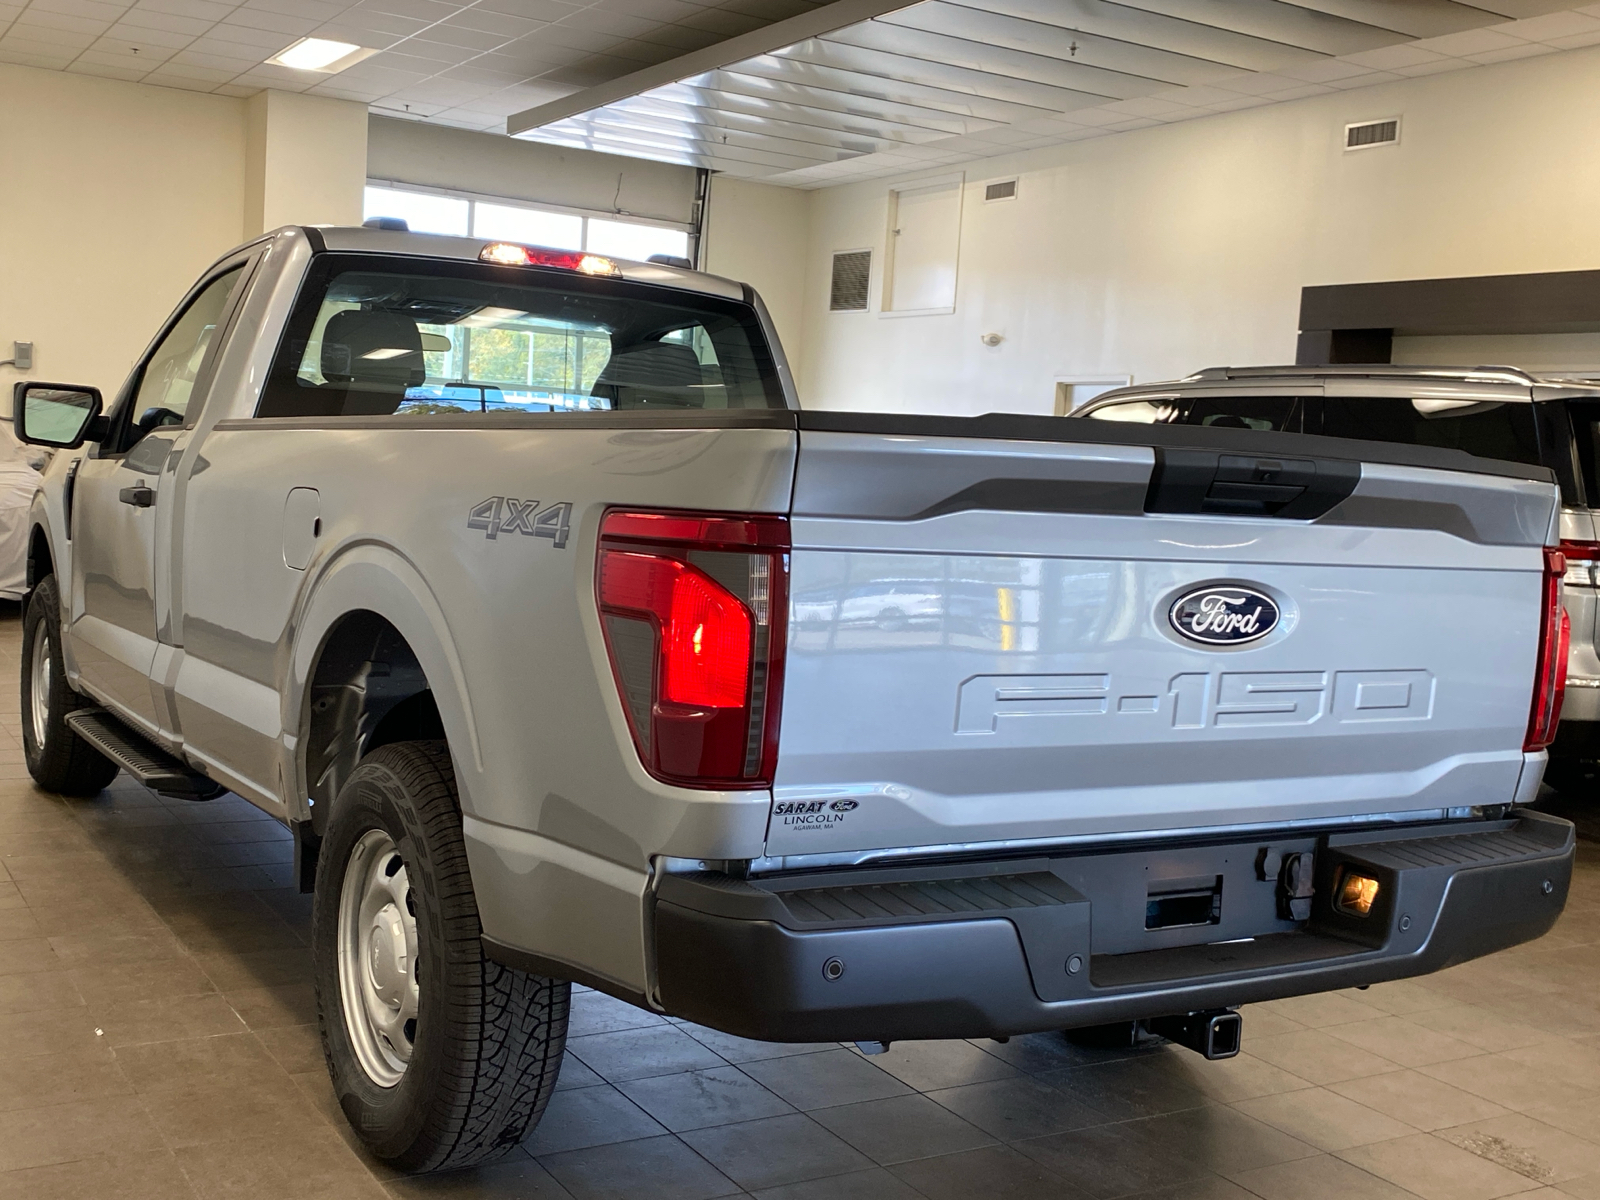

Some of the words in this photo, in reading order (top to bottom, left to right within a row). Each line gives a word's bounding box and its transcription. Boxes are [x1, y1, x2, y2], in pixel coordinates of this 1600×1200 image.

[1191, 594, 1262, 633] Ford
[953, 669, 1436, 734] F-150
[773, 800, 827, 815] SARAT
[784, 814, 844, 825] LINCOLN
